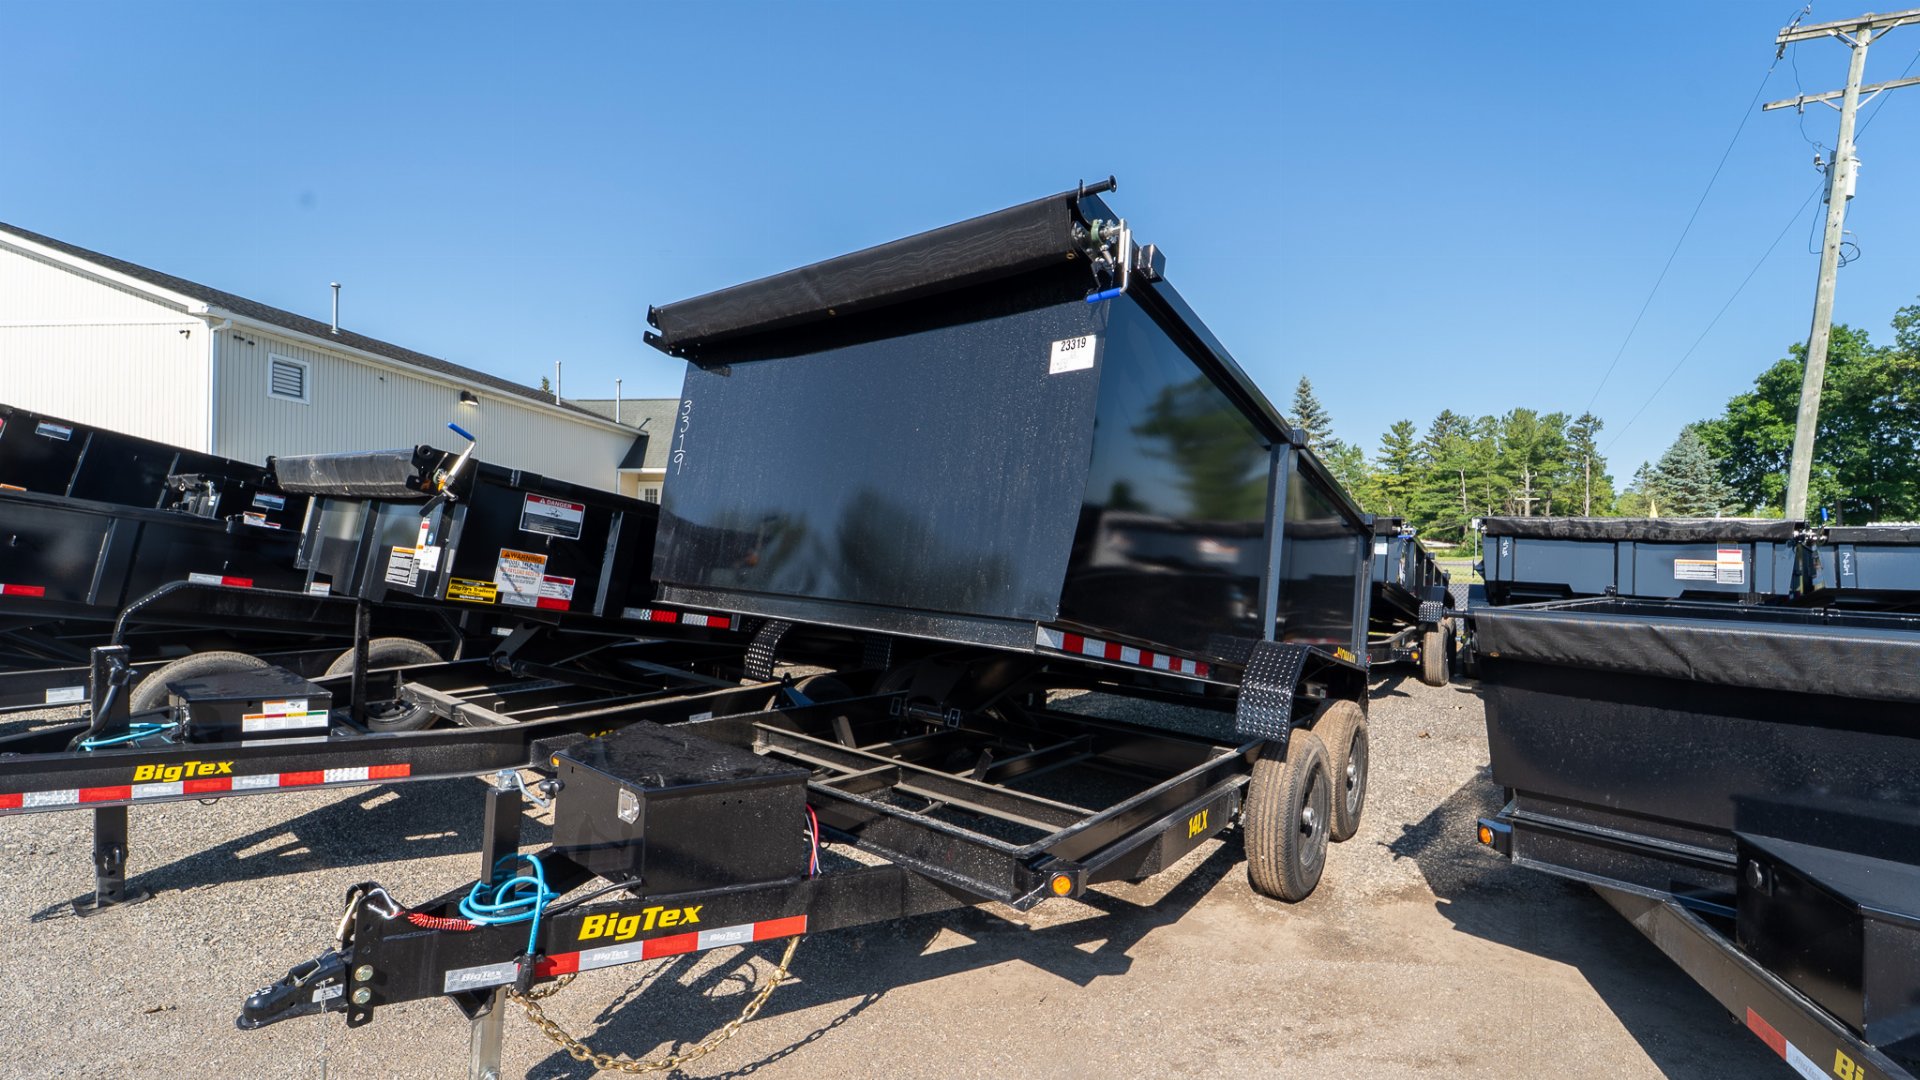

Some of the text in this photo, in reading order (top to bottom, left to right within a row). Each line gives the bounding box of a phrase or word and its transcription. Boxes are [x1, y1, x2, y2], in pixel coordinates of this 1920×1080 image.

[1060, 337, 1087, 352] 23319
[674, 400, 692, 475] 3319
[546, 499, 572, 509] DANGER
[510, 551, 542, 563] WARNING
[133, 761, 234, 783] BigTex
[1189, 809, 1208, 839] 14LX
[578, 905, 702, 941] BigTex
